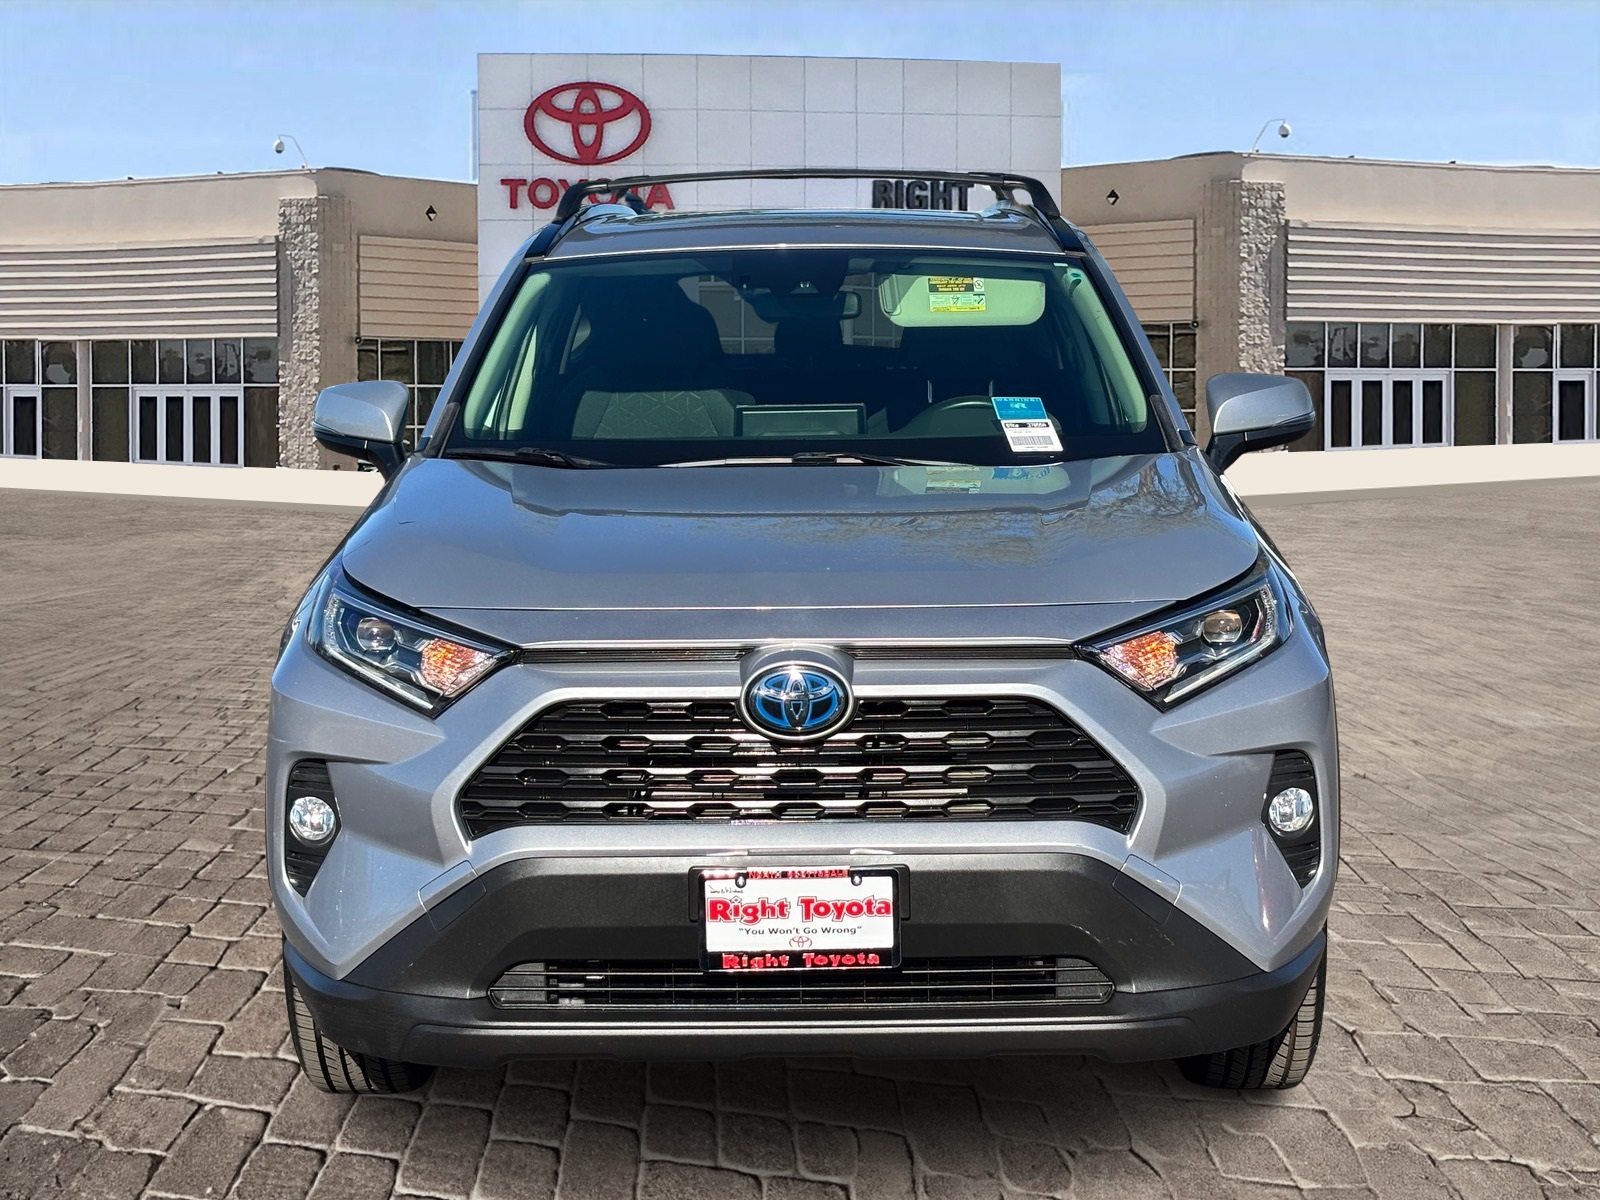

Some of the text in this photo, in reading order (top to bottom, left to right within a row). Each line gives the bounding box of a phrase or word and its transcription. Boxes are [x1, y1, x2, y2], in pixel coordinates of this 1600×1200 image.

[872, 180, 974, 211] RIGHT
[708, 895, 893, 925] Right Toyota
[768, 927, 801, 935] Won't
[803, 926, 818, 935] Go
[722, 952, 880, 969] Right Toyota
